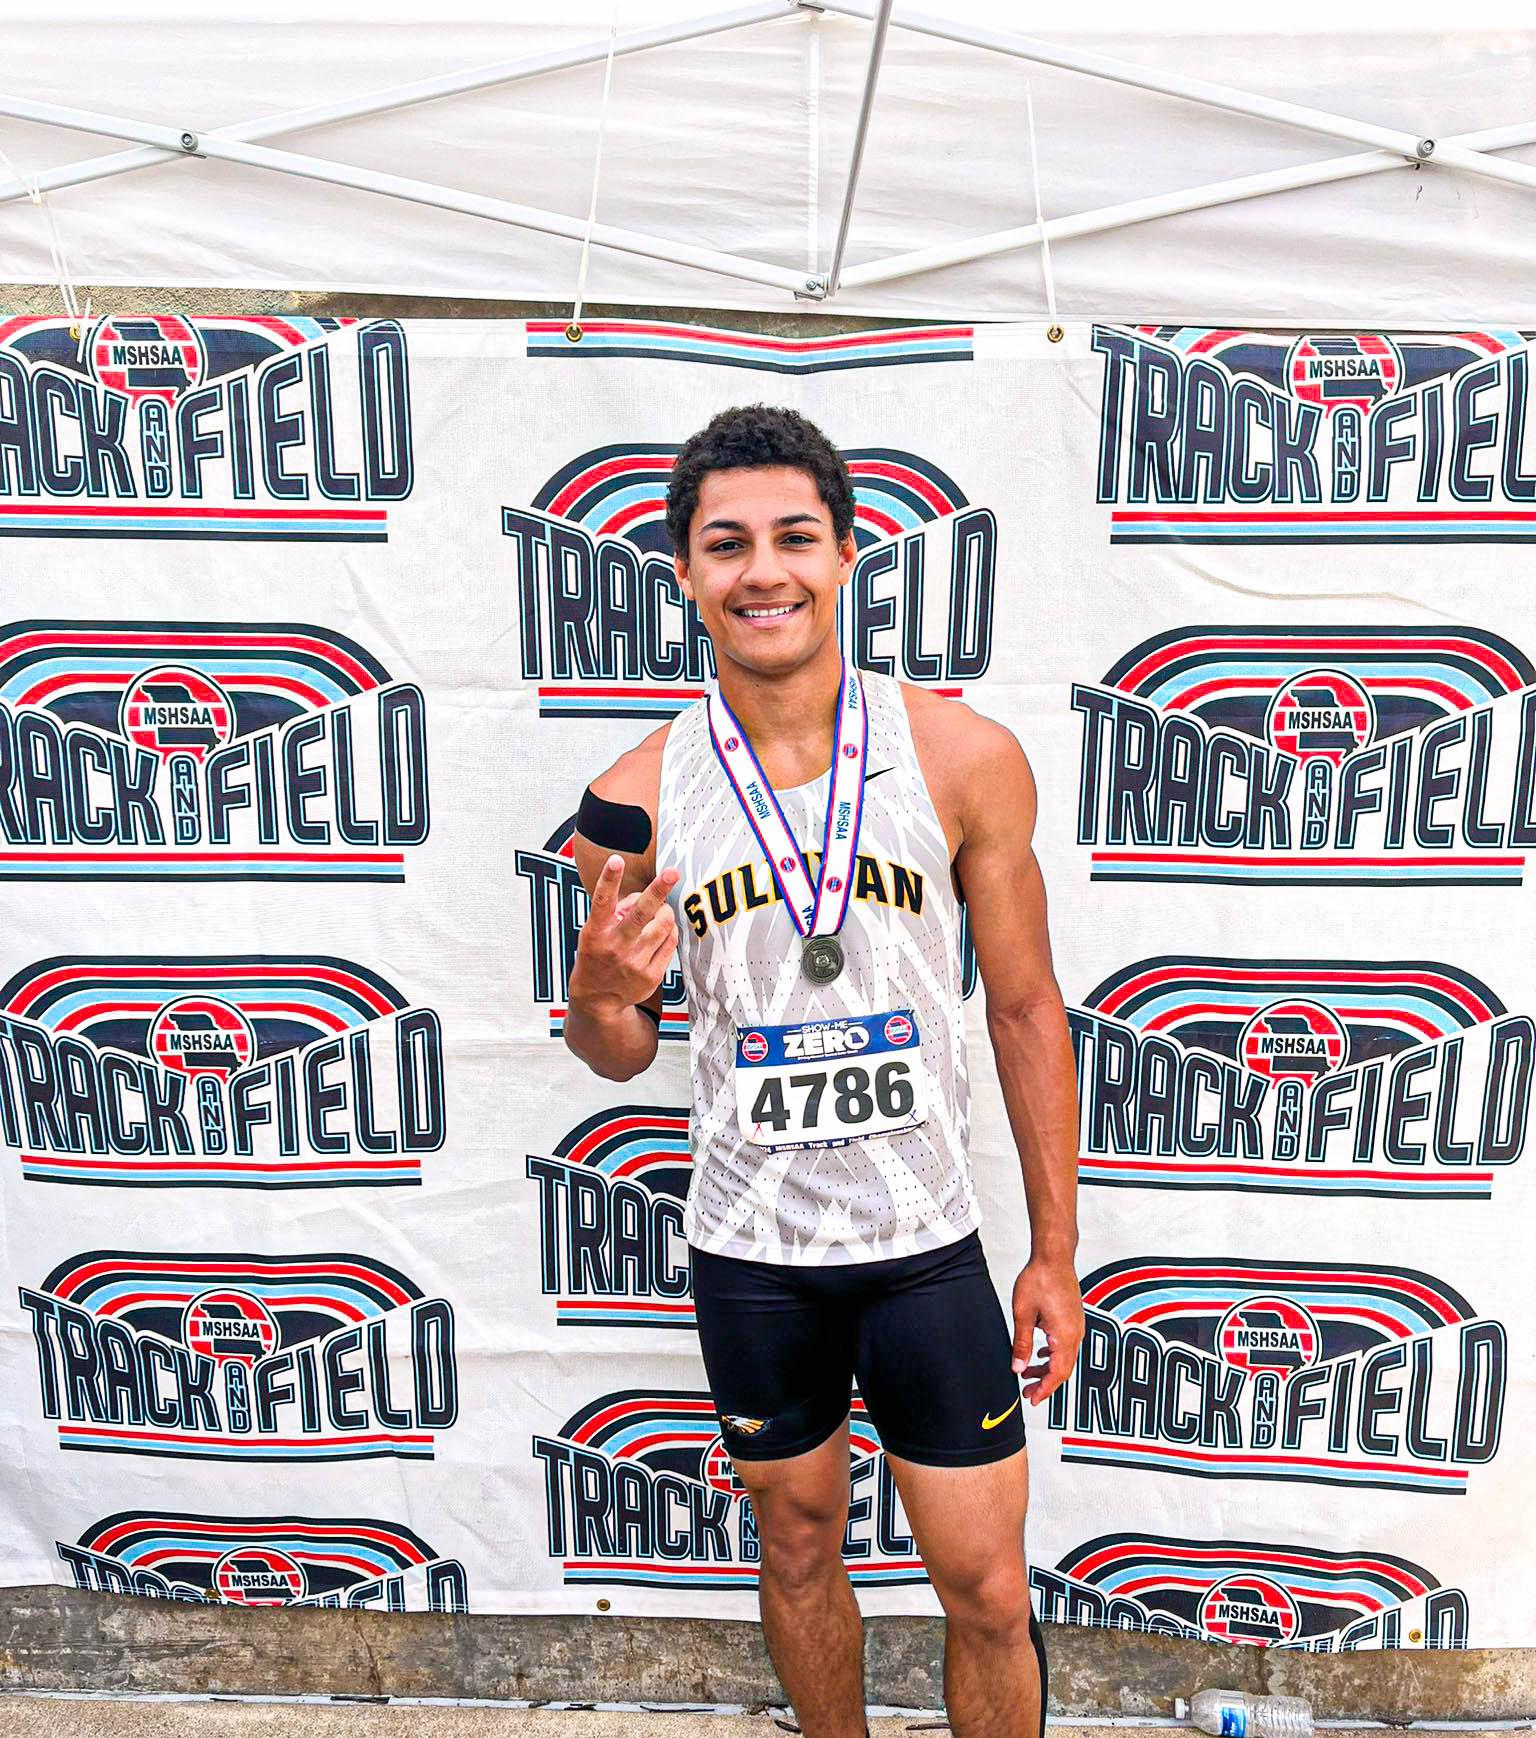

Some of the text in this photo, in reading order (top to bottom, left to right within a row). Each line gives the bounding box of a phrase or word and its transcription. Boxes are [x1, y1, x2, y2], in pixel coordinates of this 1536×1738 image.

[113, 345, 183, 366] MSHSAA
[1310, 358, 1380, 378] MSHSAA
[0, 319, 415, 501] ACK AND FIELD
[1091, 324, 1536, 504] TRACK AND FIEL
[838, 507, 997, 680] ELD
[144, 706, 213, 726] MSHSAA
[1288, 711, 1353, 730] MSHSAA
[170, 754, 201, 846] AND
[205, 683, 430, 847] FIELD
[1071, 683, 1298, 850] TRACK
[1301, 760, 1332, 850] AND
[746, 780, 771, 820] MSHSAA
[835, 801, 851, 840] MSHSAA
[683, 852, 924, 937] SULAN
[170, 1034, 234, 1052] MSHSAA
[782, 1026, 870, 1058] ZERO
[1261, 1037, 1326, 1055] MSHSAA
[197, 1074, 229, 1156] AND
[229, 1008, 446, 1156] FIELD
[750, 1061, 914, 1131] 4786
[1273, 1080, 1304, 1162] AND
[1306, 1015, 1536, 1166] FIELD
[526, 1154, 694, 1299] TRAC
[201, 1320, 260, 1339] MSHSAA
[1237, 1331, 1300, 1349] MSHSAA
[19, 1286, 459, 1433] TRACK AND FIELD
[1250, 1373, 1280, 1450] AND
[1282, 1320, 1508, 1465] FIELD
[532, 1434, 732, 1561] TRACK
[231, 1572, 287, 1588] MSHSAA
[1219, 1605, 1279, 1626] MSHSAA
